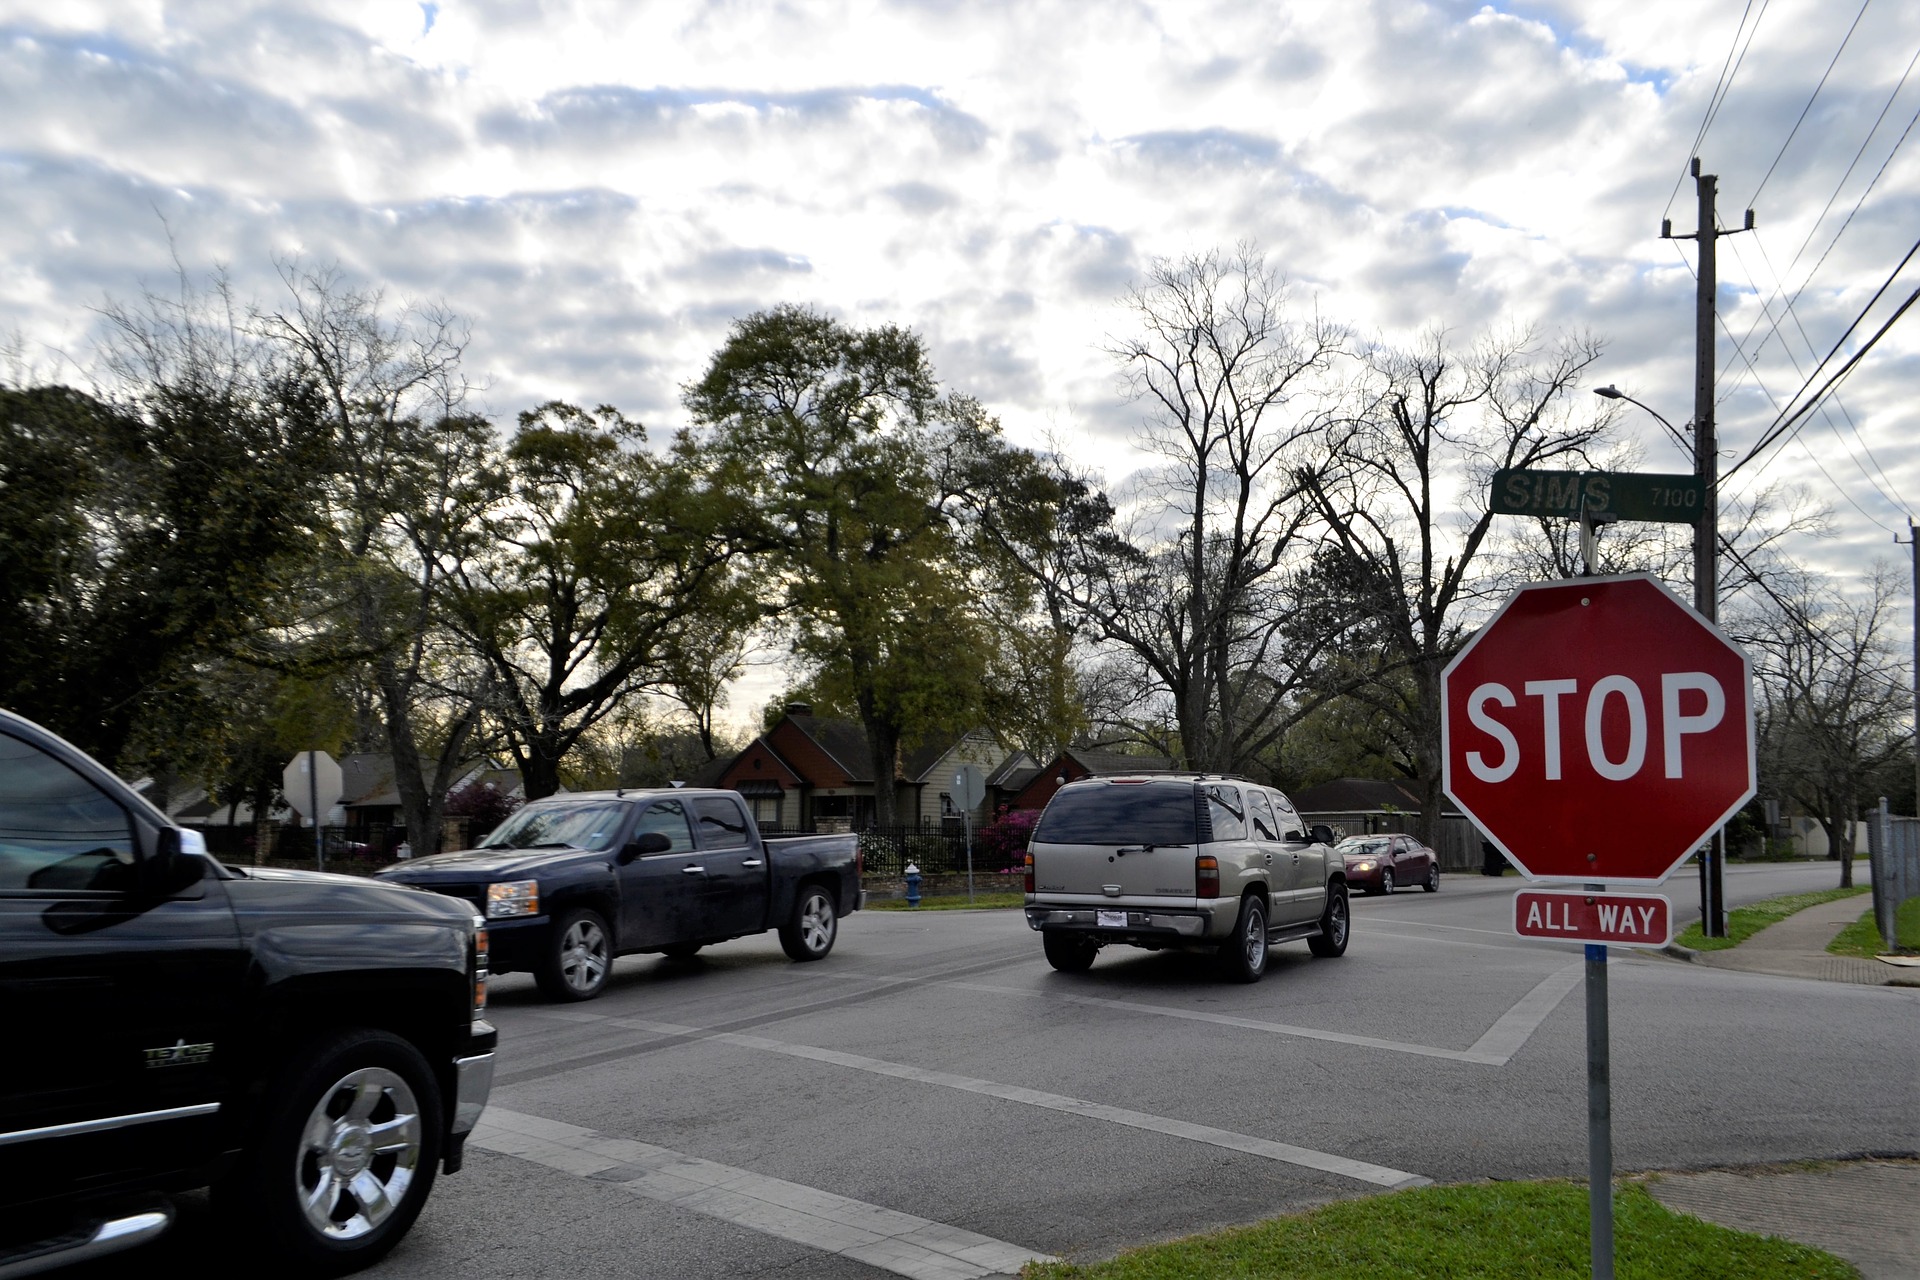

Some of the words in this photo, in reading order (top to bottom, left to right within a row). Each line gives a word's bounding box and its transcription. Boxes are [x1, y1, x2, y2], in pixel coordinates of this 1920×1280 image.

[1503, 474, 1611, 512] SIMS
[1651, 488, 1697, 507] 7100
[1465, 672, 1726, 784] STOP
[1526, 901, 1578, 931] ALL
[1597, 904, 1656, 935] WAY
